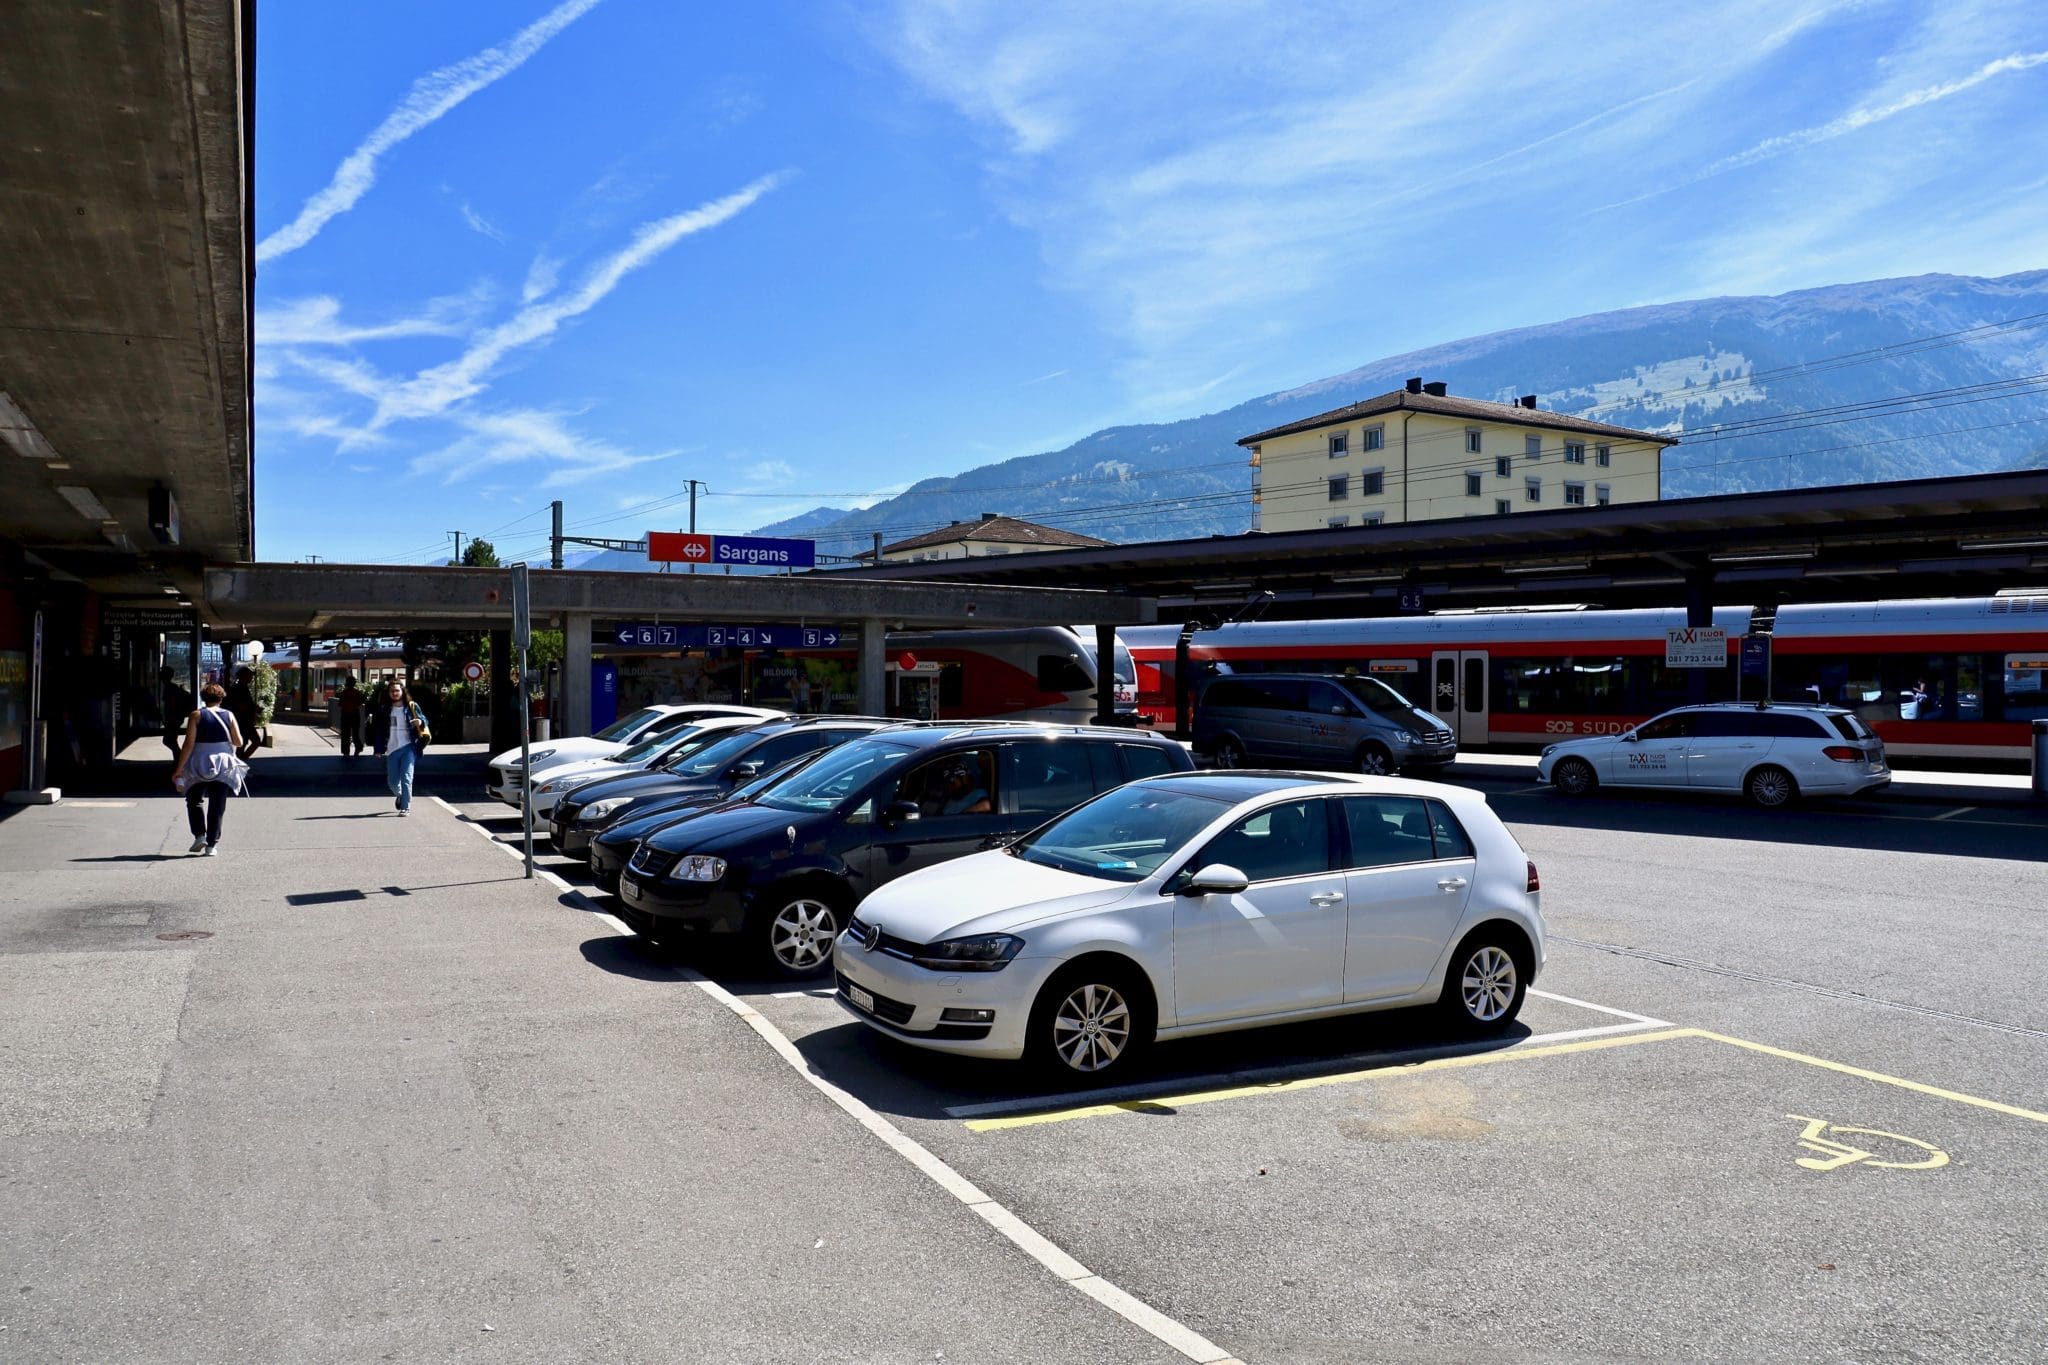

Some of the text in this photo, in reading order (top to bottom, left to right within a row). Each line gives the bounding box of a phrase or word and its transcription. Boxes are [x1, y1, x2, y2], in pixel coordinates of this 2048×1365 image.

[719, 544, 789, 563] Sargans
[642, 632, 651, 642] 6
[663, 632, 671, 642] 7
[713, 633, 721, 643] 2
[741, 633, 750, 643] 4
[808, 633, 816, 644] 5
[1669, 629, 1697, 644] TAXI
[763, 667, 798, 677] BILDUNG
[1311, 724, 1328, 736] TAXI
[1629, 753, 1648, 763] TAXI
